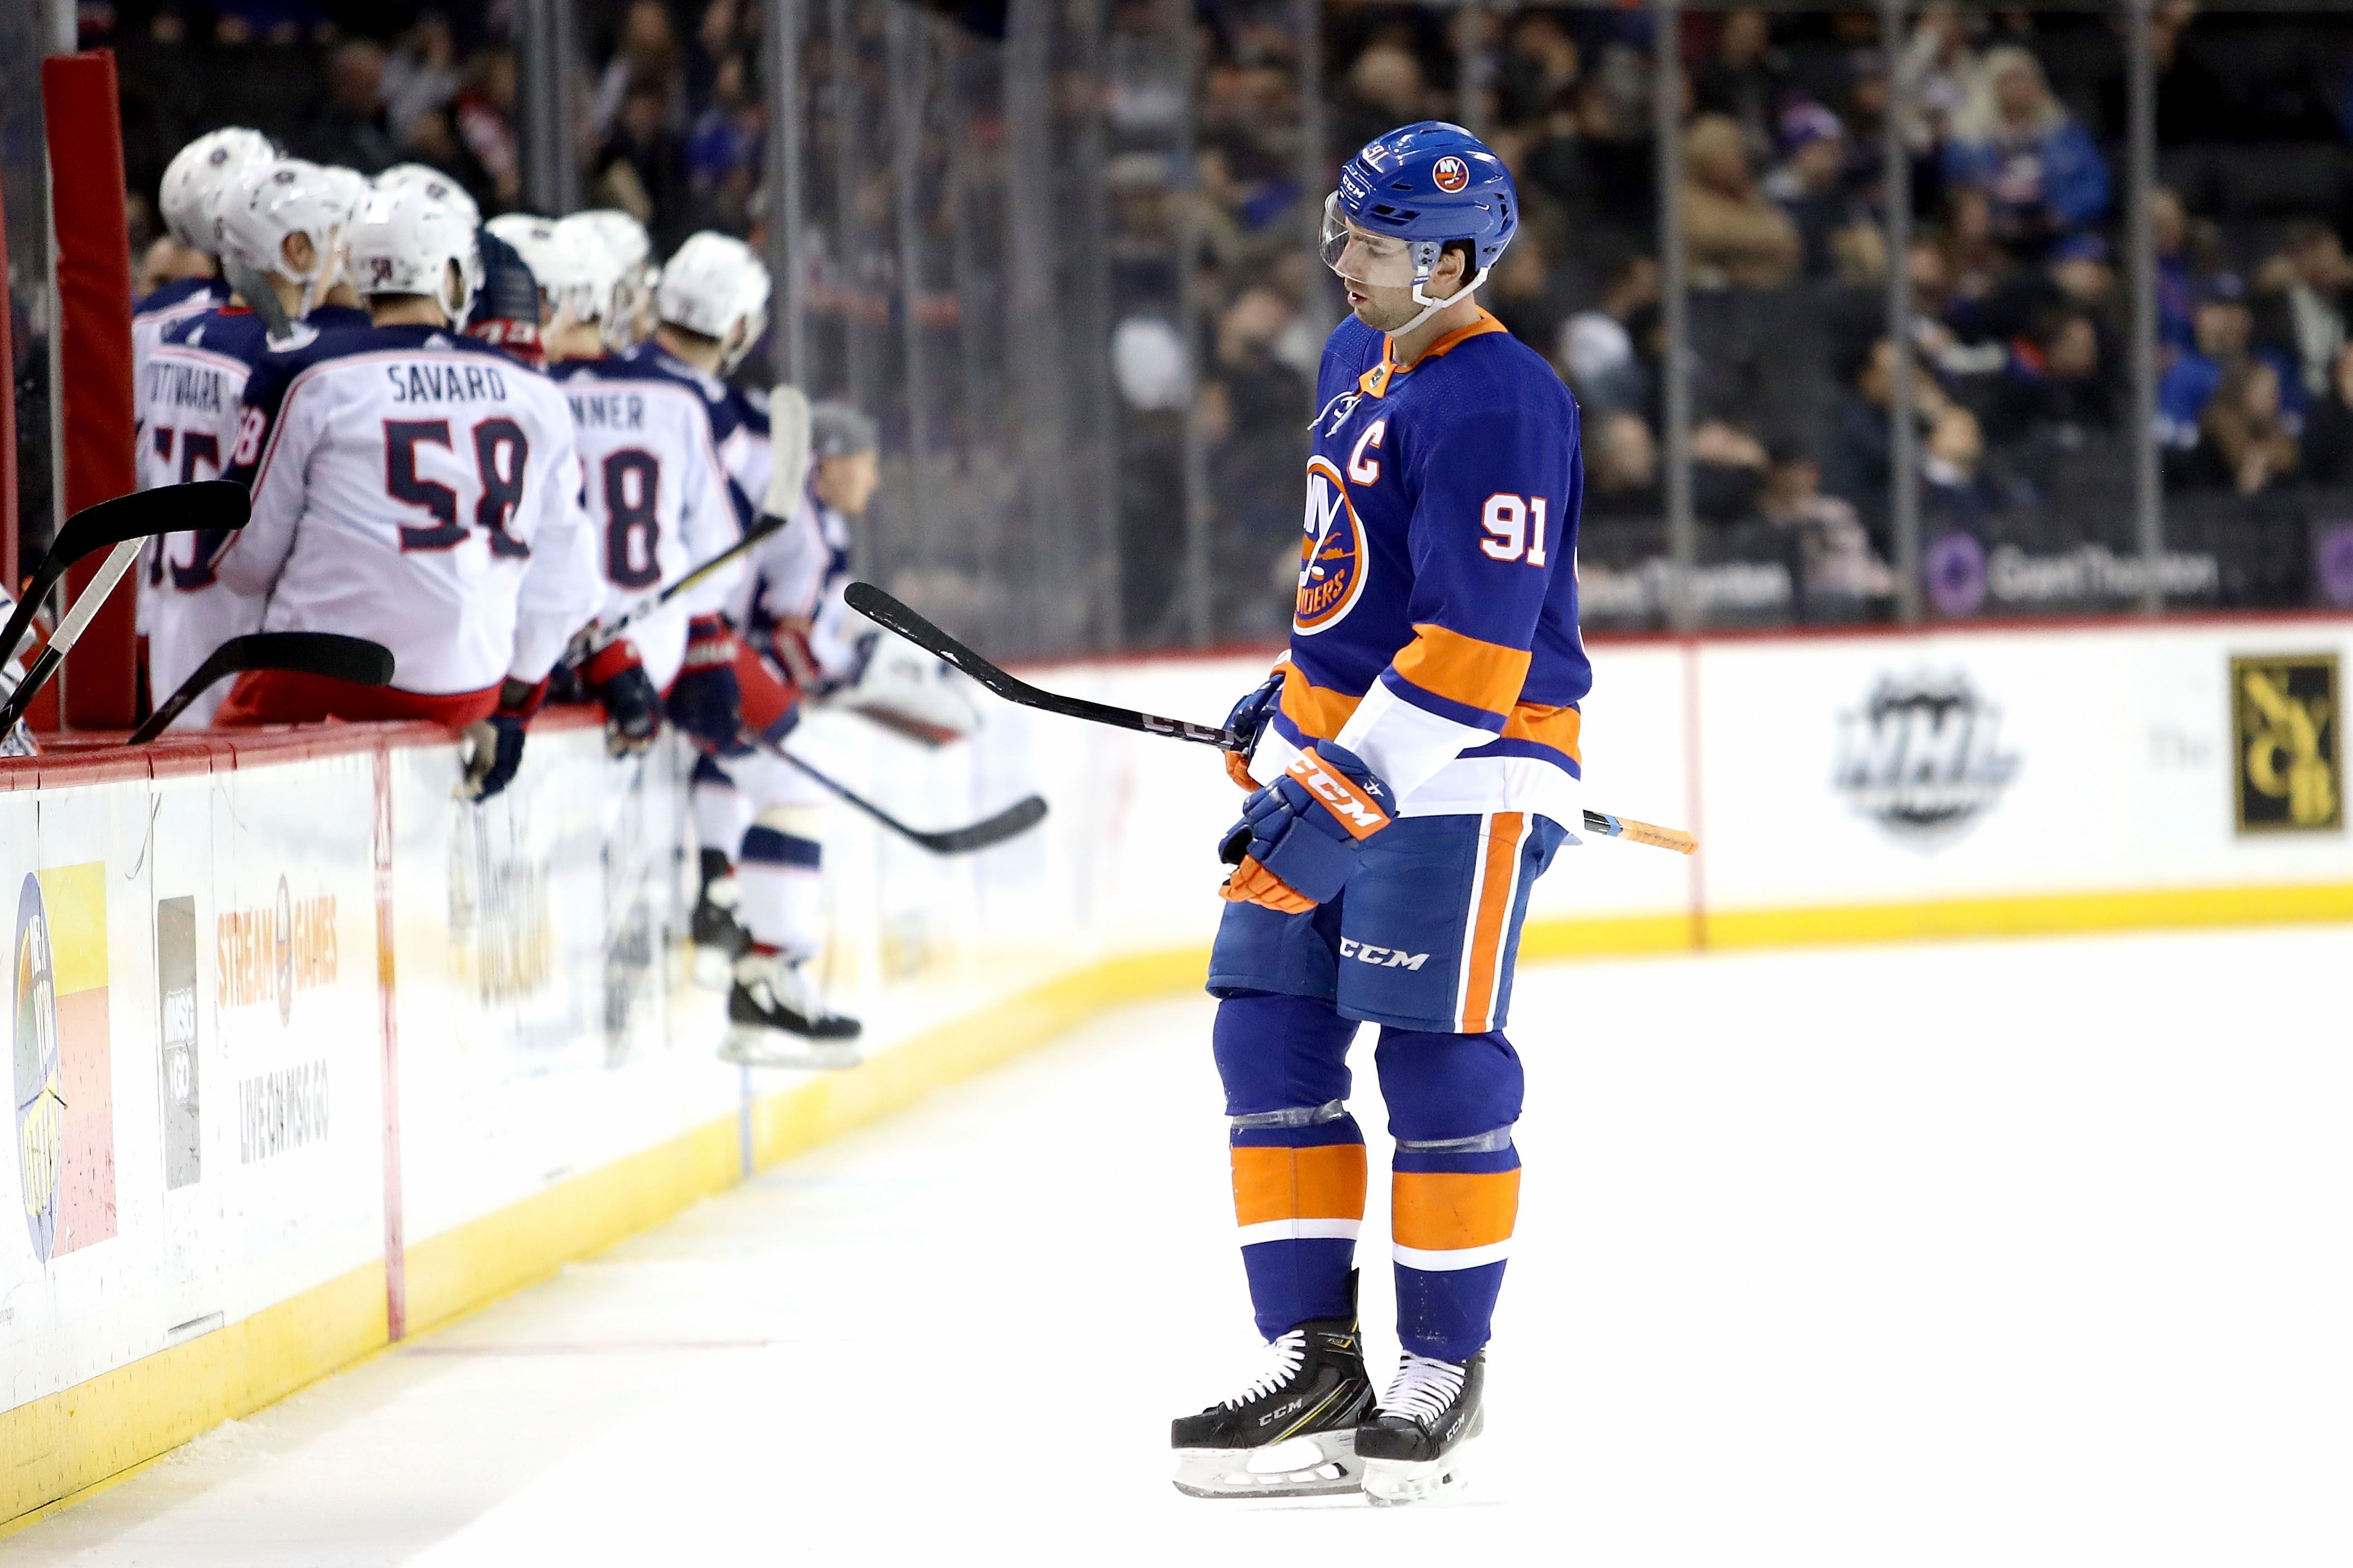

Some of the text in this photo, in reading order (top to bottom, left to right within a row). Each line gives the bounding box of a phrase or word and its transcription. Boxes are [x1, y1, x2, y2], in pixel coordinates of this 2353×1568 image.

[1343, 173, 1366, 198] CCM
[388, 363, 508, 404] SAVARD
[1347, 418, 1386, 487] C
[381, 417, 531, 561] 58
[1479, 491, 1547, 568] 91
[1289, 753, 1382, 827] CCM
[217, 907, 273, 1009] STREAM
[294, 894, 337, 991] GAMES
[1340, 936, 1430, 971] CCM
[239, 1057, 329, 1165] LIVE ON MSG GO
[1259, 1398, 1303, 1427] CCM
[1446, 1414, 1465, 1441] CCM
